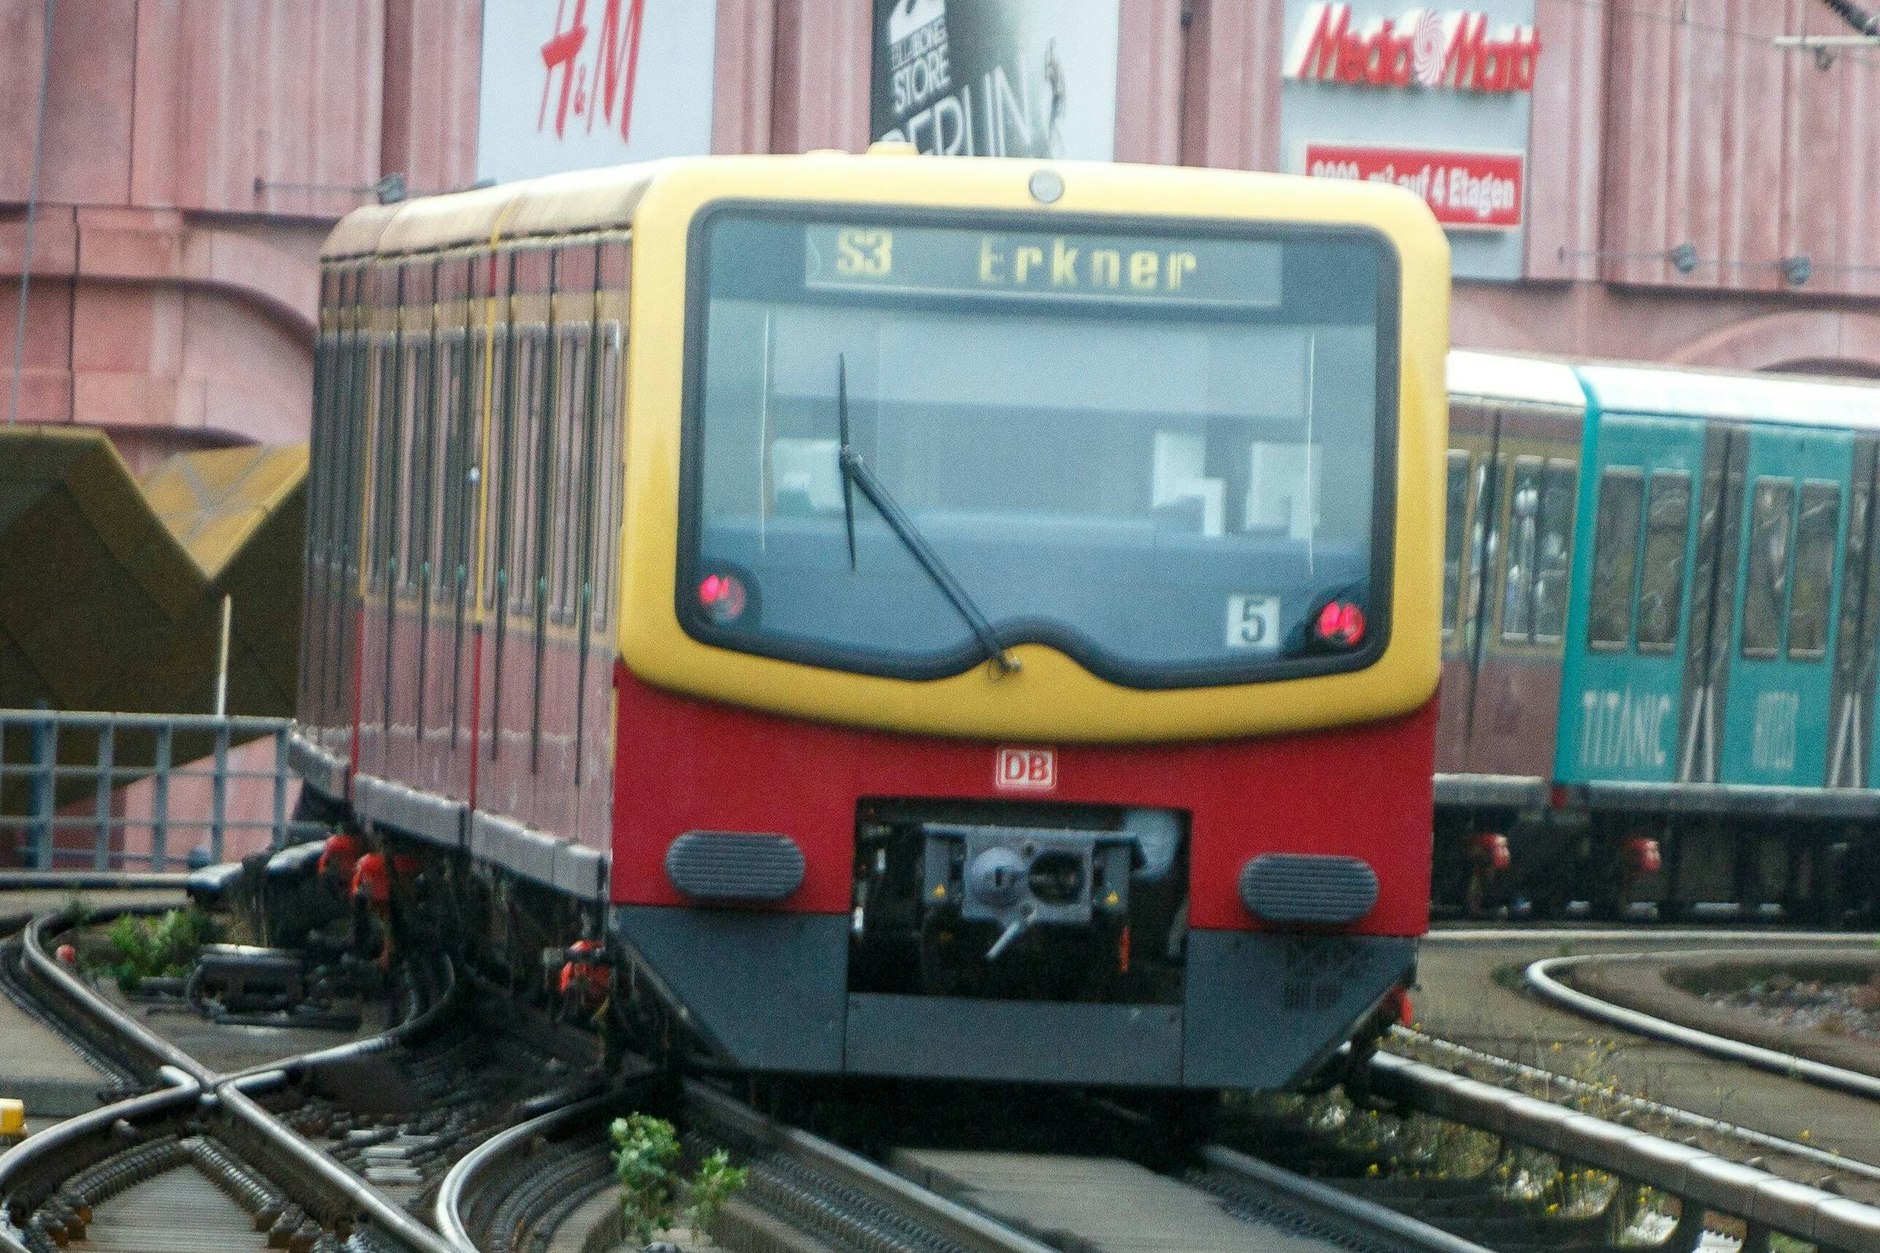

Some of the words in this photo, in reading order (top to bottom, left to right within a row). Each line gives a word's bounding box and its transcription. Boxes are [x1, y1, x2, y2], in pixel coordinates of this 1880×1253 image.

[538, 0, 645, 143] H&M
[1297, 3, 1414, 86] Media
[880, 65, 1033, 157] ERLIN
[893, 44, 952, 115] STORE
[1449, 167, 1516, 218] Etagen
[835, 227, 893, 276] S3
[979, 235, 1198, 290] Erkner
[1239, 594, 1268, 644] 5
[1002, 748, 1052, 783] DB
